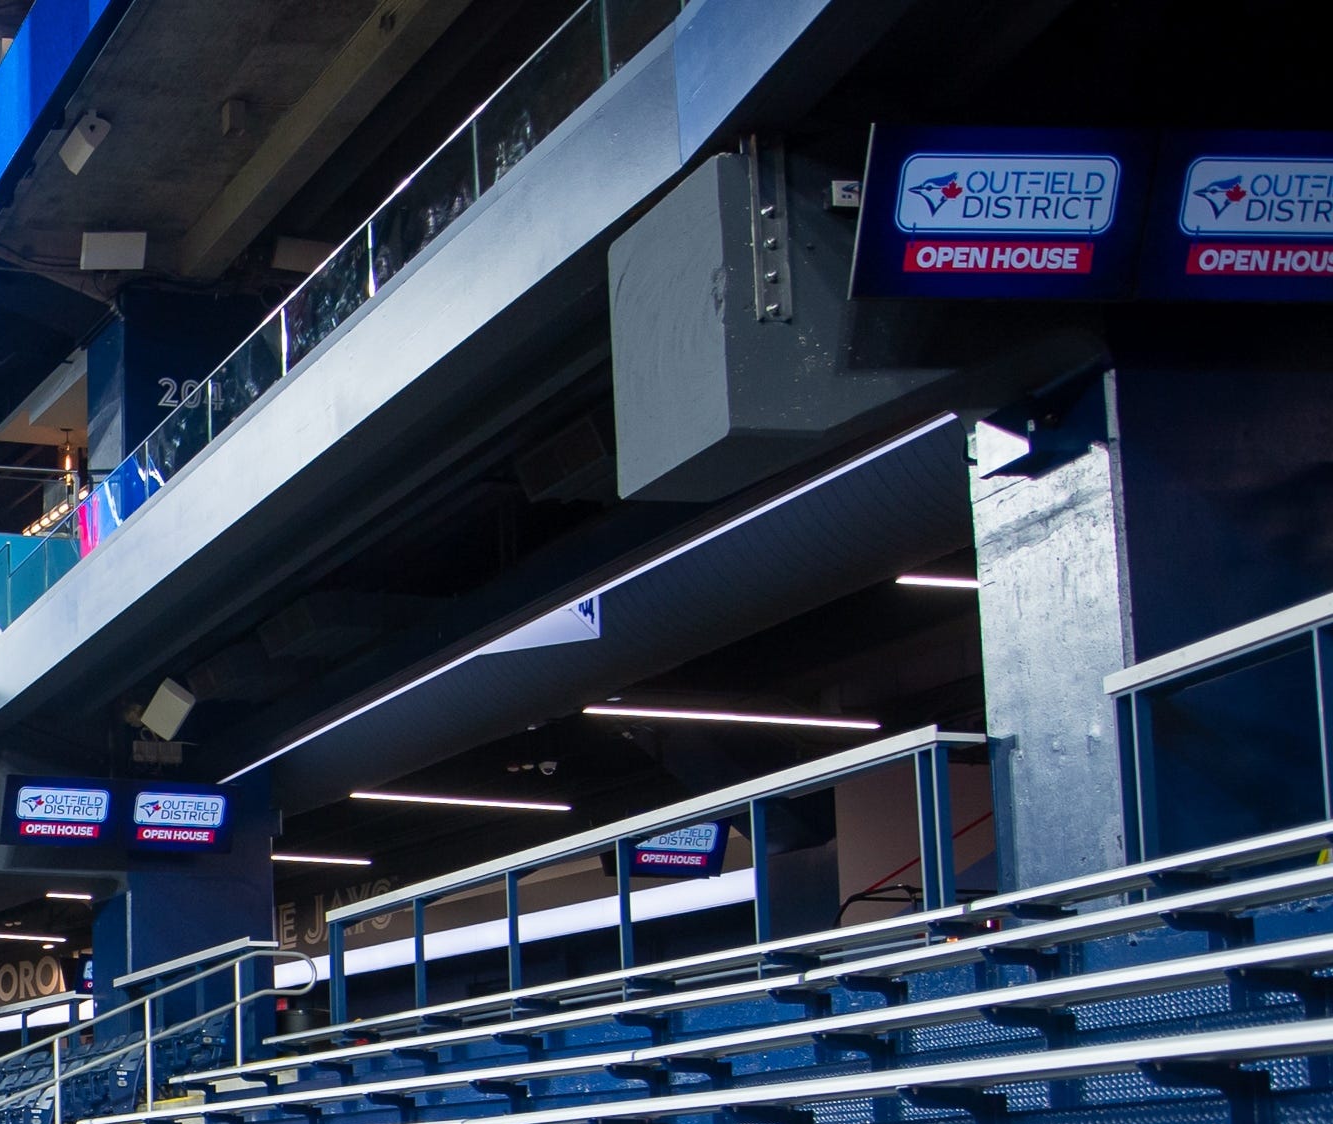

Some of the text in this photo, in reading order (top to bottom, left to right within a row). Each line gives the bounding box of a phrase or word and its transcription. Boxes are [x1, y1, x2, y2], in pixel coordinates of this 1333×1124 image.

[966, 171, 1107, 196] OUTFIELD
[1250, 174, 1333, 198] OUTFI
[962, 196, 1103, 220] DISTRICT
[1245, 199, 1333, 222] DISTR
[916, 246, 1080, 271] OPEN HOUSE
[1198, 248, 1270, 272] OPEN
[45, 794, 103, 807] OUTFIELD
[162, 800, 219, 812] OUTFIELD
[44, 805, 101, 816] DISTRICT
[161, 810, 218, 822] DISTRICT
[25, 823, 94, 837] OPEN HOUSE
[142, 829, 209, 842] OPEN HOUSE
[658, 836, 710, 847] DISTRICT
[641, 854, 702, 865] OPEN HOUSE
